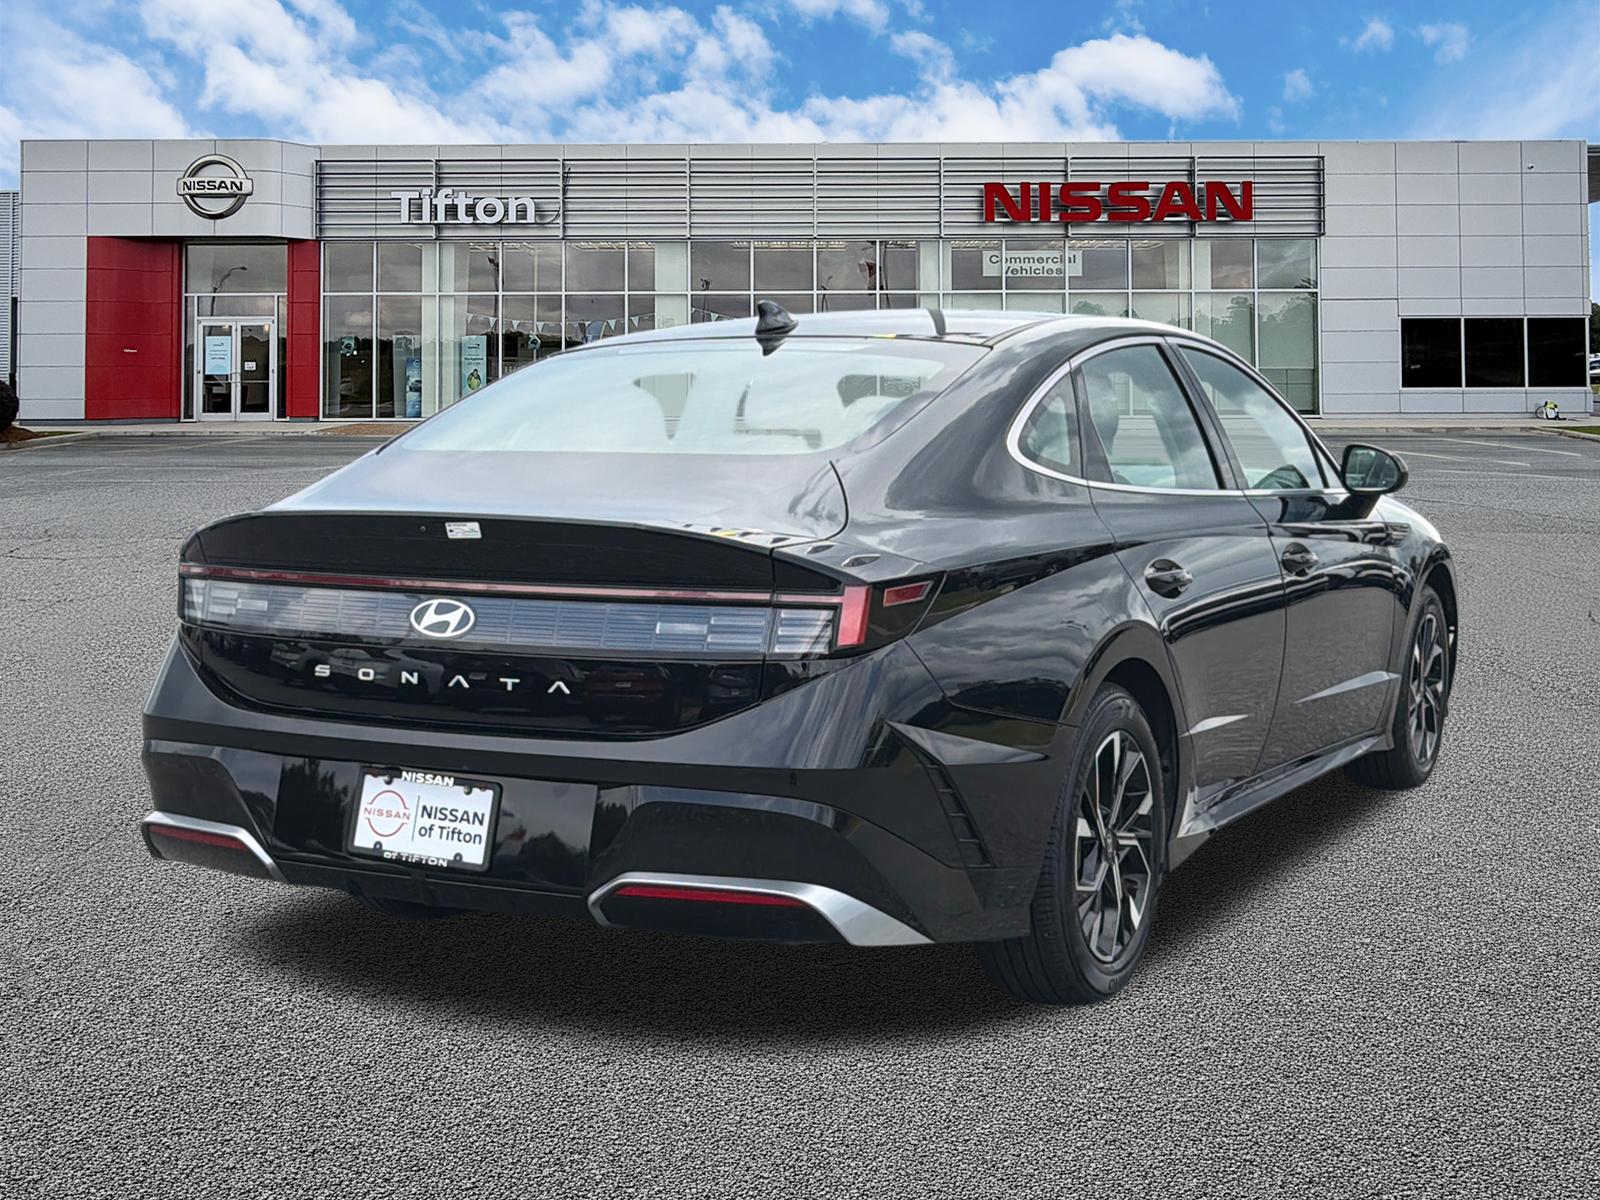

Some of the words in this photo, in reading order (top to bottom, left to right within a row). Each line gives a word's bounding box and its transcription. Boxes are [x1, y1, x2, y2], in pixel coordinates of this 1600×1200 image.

[183, 180, 243, 192] NISSAN
[390, 187, 536, 224] Tifton
[983, 181, 1253, 223] NISSAN
[314, 663, 571, 695] SONATA
[401, 770, 455, 787] NISSAN
[363, 806, 411, 821] NISSAN
[420, 804, 485, 827] NISSAN
[418, 823, 435, 839] of
[437, 825, 483, 846] Tifton
[400, 852, 448, 868] TIFTON
